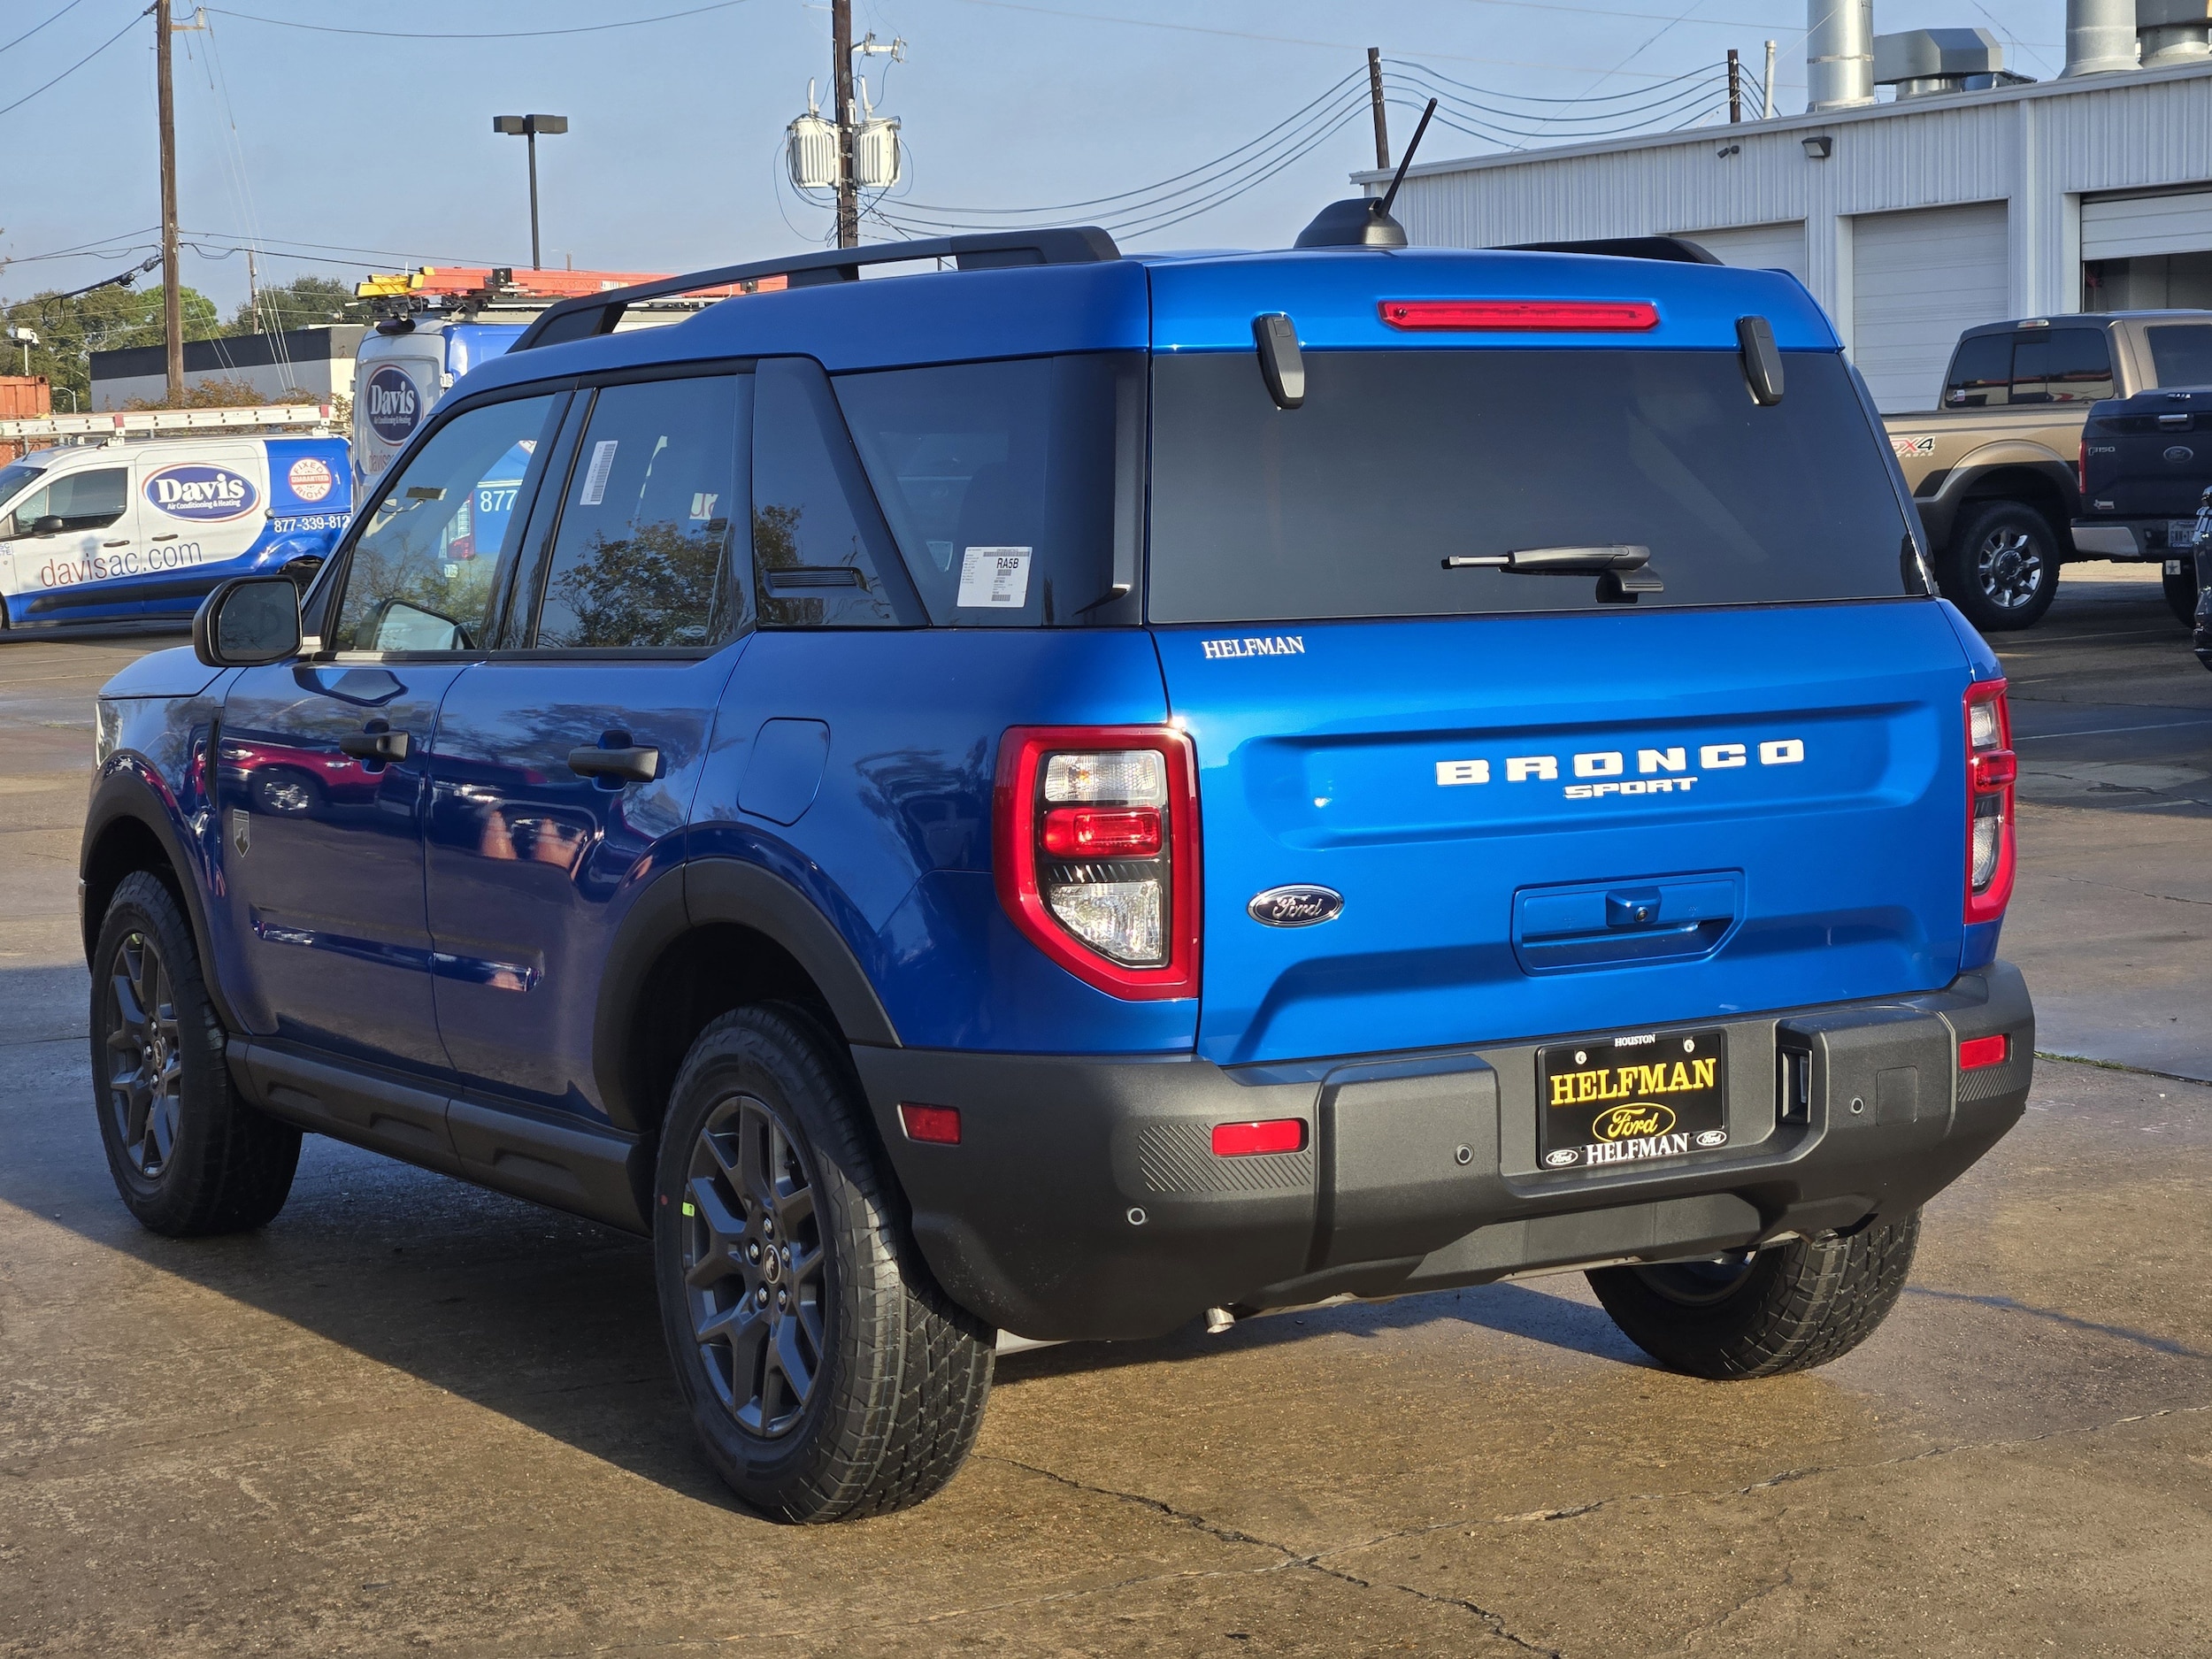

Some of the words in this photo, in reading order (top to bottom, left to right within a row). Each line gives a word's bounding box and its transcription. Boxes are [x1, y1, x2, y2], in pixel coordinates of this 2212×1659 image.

[370, 380, 415, 415] Davis
[293, 461, 324, 474] FIXED
[156, 472, 245, 503] Davis
[296, 485, 326, 499] RIGHT
[177, 500, 213, 510] Conditioning
[218, 499, 241, 508] Heating
[41, 541, 203, 588] davisac.com
[996, 557, 1019, 569] RA5B
[1202, 636, 1305, 658] HELFMAN
[1435, 739, 1805, 786] BRONCO
[1563, 776, 1698, 799] SPORT
[1272, 894, 1324, 919] Ford
[1614, 1033, 1656, 1048] HOUSTON
[1550, 1057, 1717, 1105] HELFMAN
[1607, 1108, 1659, 1138] Ford
[1551, 1151, 1573, 1164] Ford
[1586, 1133, 1689, 1165] HELFMAN
[1701, 1132, 1723, 1145] Ford
